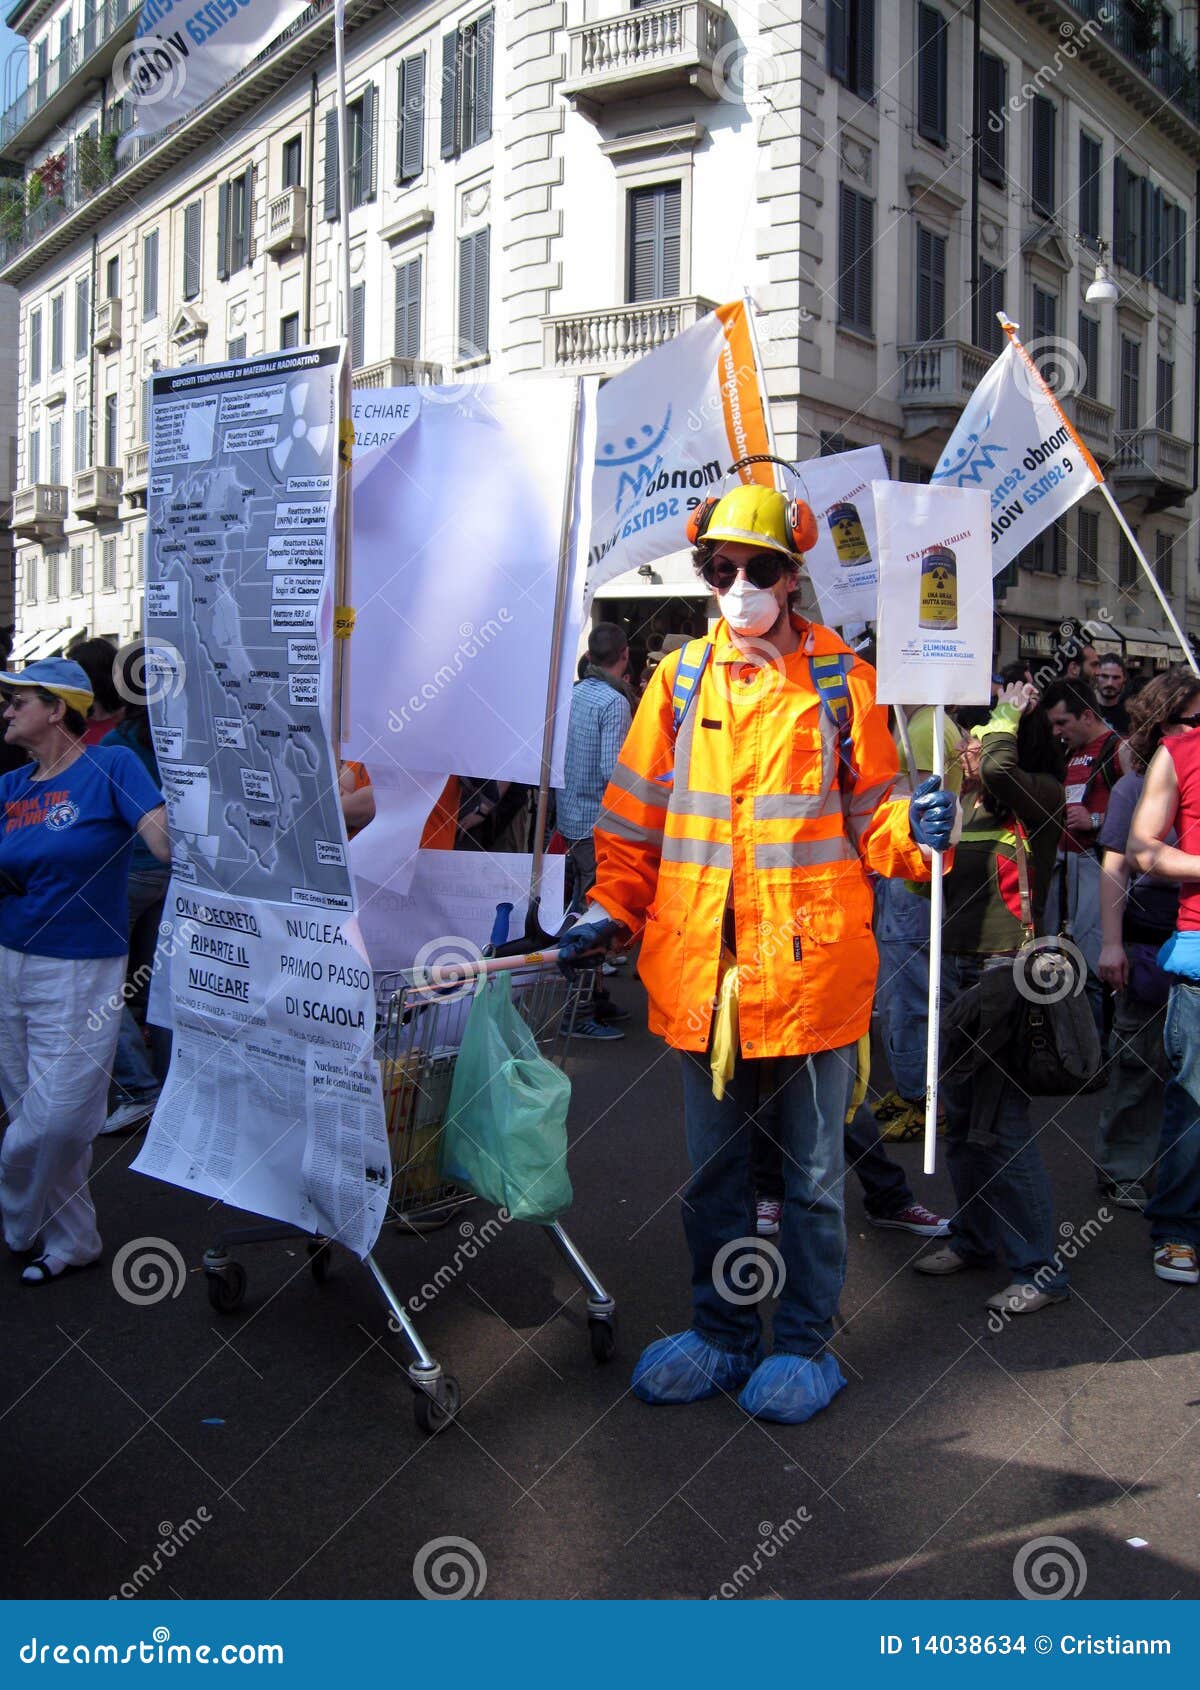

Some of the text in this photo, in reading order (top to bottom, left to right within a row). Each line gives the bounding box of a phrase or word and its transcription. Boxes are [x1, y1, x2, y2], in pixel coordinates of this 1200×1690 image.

[171, 354, 320, 388] DEPOSITI TEMPORANEI DI MATERIALE RADIOATTIVO
[364, 404, 412, 419] CHIARE
[289, 479, 316, 489] Deposito
[287, 506, 311, 515] Reattore
[283, 538, 324, 548] Reattore LENA
[943, 530, 973, 547] ITALIANA
[269, 548, 290, 557] Deposito
[294, 558, 323, 567] Voghera
[295, 576, 322, 586] nucleare
[297, 586, 320, 595] Caorso
[922, 643, 957, 652] ELIMINARE
[292, 676, 318, 685] Deposito
[190, 933, 250, 965] RIPARTE IL
[280, 954, 370, 991] PRIMO PASSO
[188, 967, 250, 999] NUCLEARE
[285, 996, 365, 1030] DI SCAJOLA
[313, 1059, 343, 1076] Nucleare,
[312, 1075, 325, 1087] per
[326, 1075, 333, 1086] le
